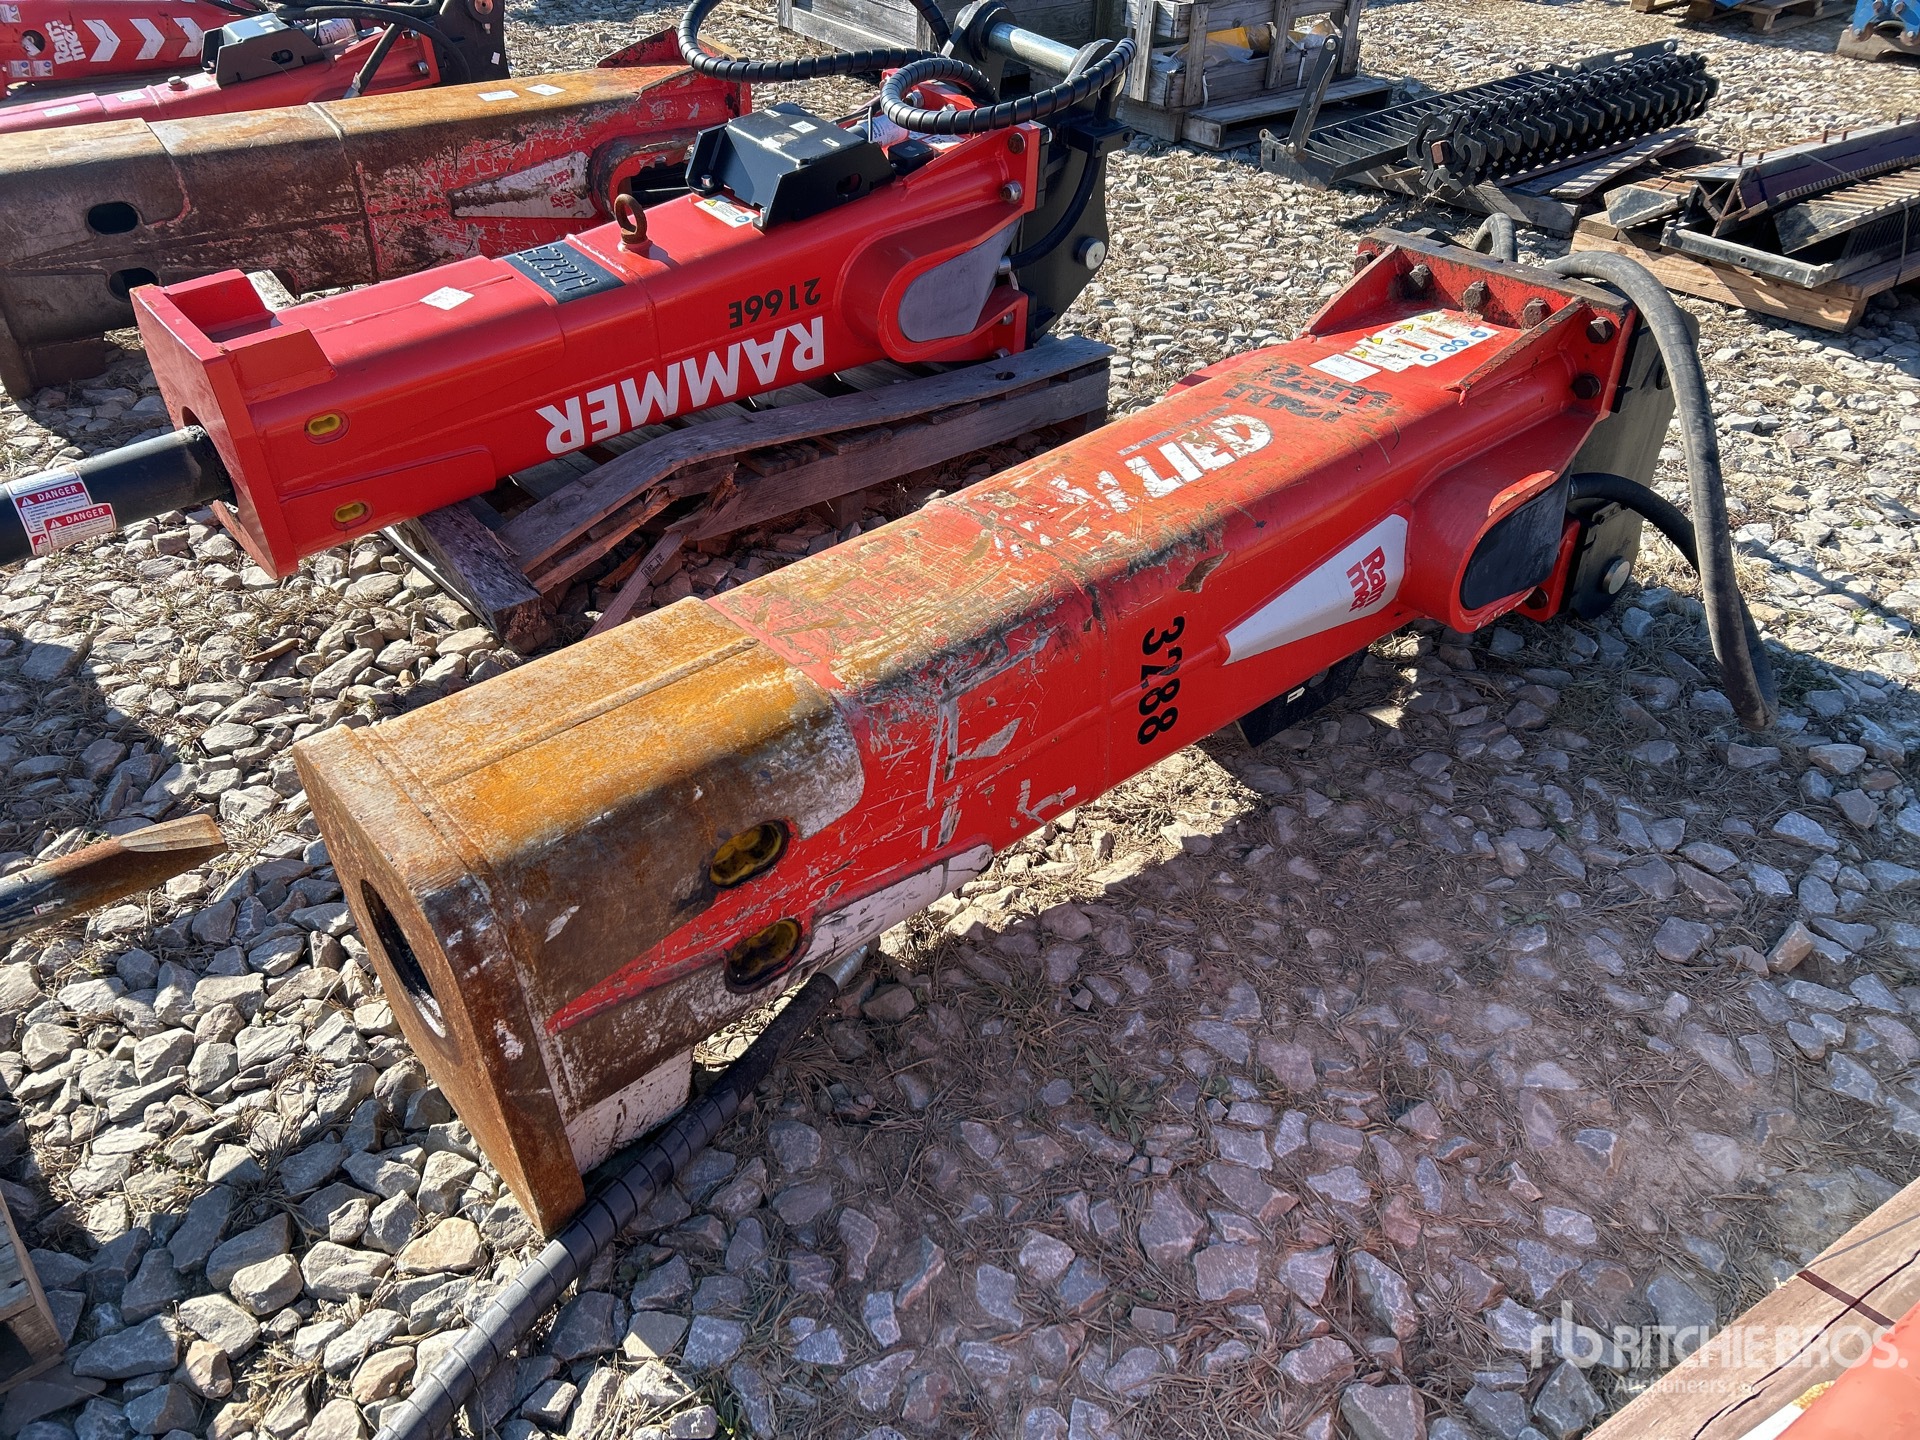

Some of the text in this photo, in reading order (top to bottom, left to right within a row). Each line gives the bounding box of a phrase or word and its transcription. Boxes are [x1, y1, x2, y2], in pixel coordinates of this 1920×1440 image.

[728, 277, 821, 329] 2166E
[535, 315, 825, 455] RAMMER
[37, 484, 79, 502] DANGER
[65, 507, 105, 524] DANGER
[1345, 560, 1371, 613] mer
[1361, 545, 1387, 608] Ram
[1137, 615, 1186, 745] 3288
